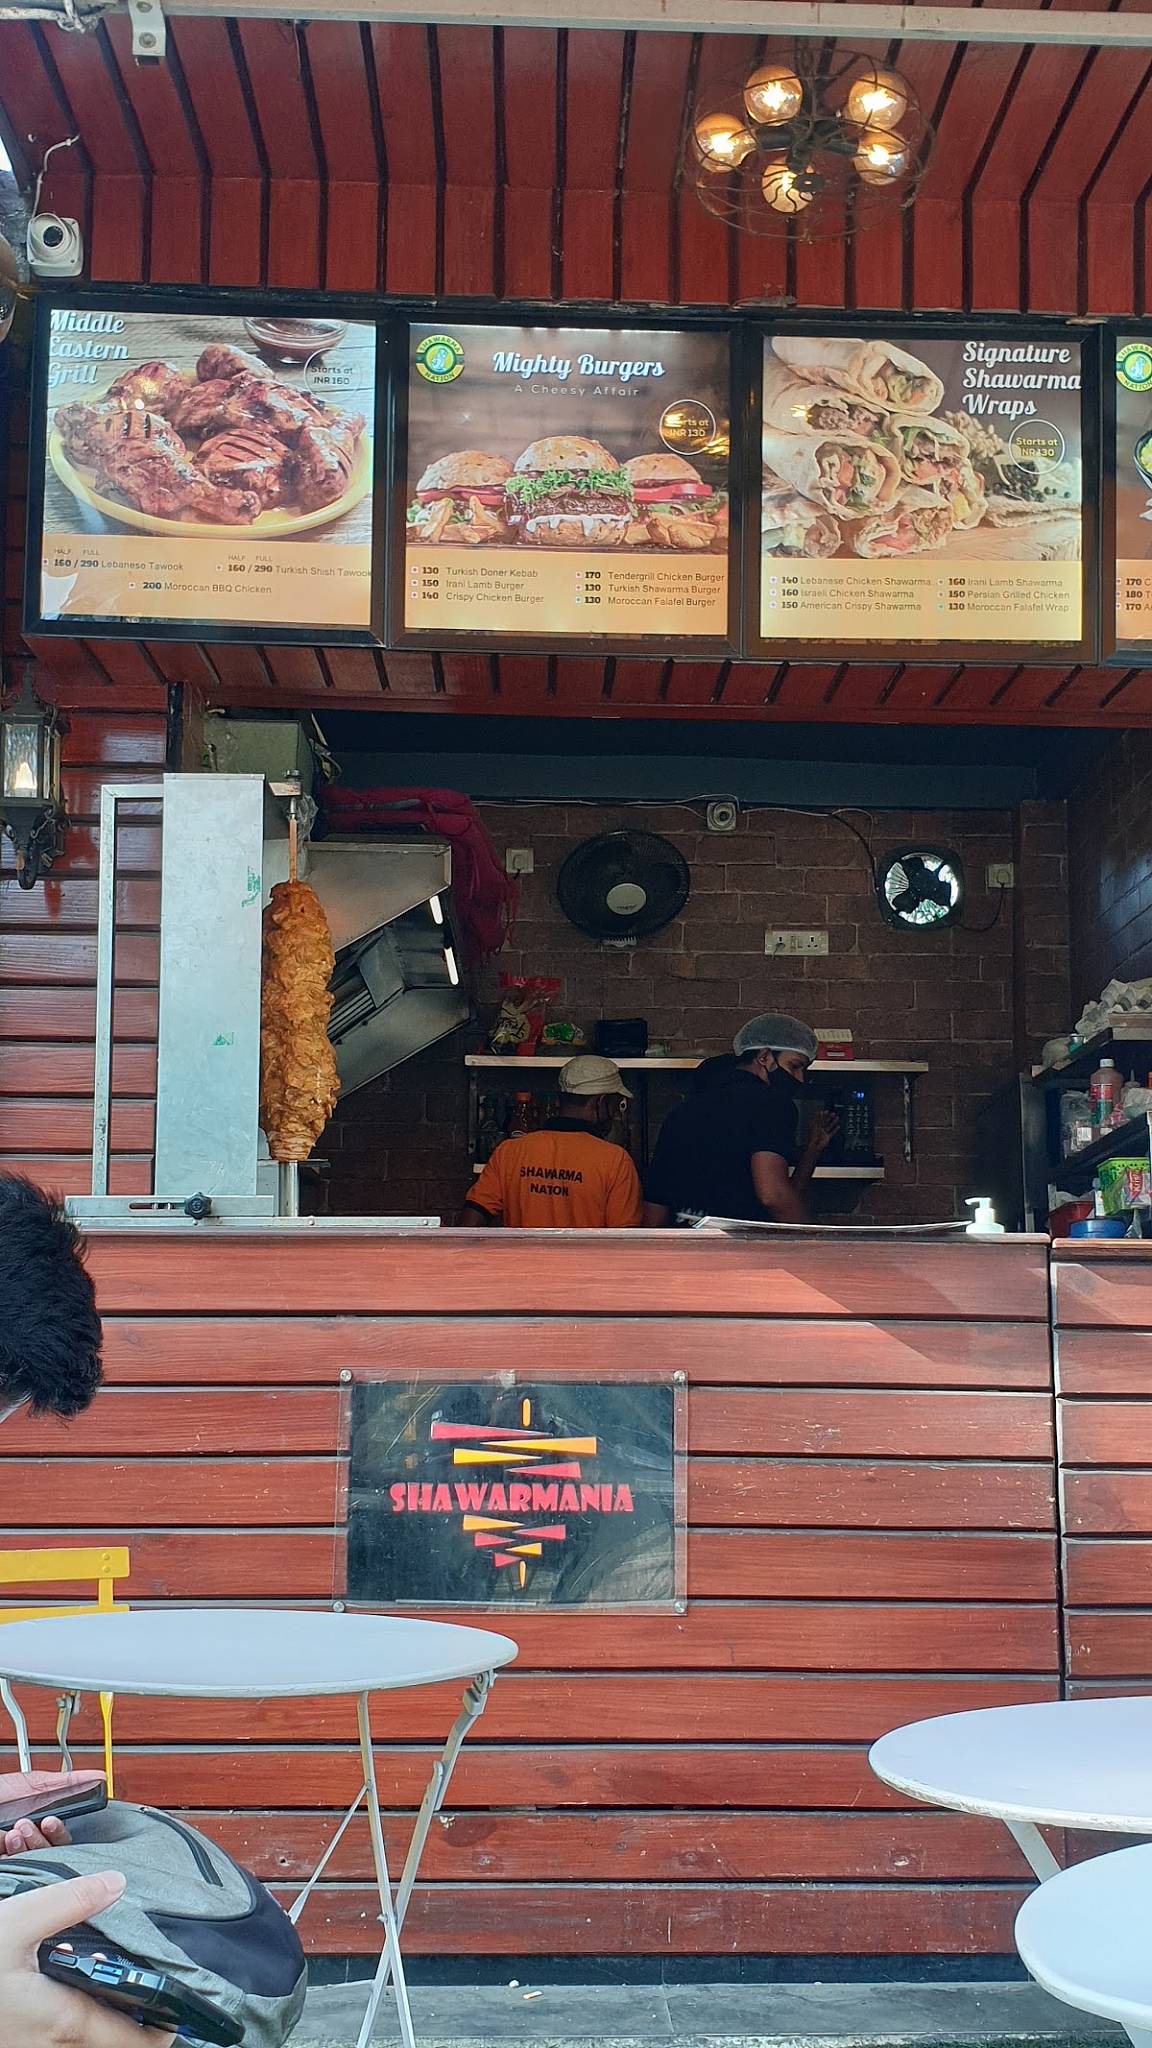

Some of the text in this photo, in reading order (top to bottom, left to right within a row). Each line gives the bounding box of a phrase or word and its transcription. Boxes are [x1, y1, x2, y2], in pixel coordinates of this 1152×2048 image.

[51, 311, 125, 334] Middle
[49, 336, 129, 360] Eastern
[962, 341, 1071, 368] Signature
[311, 366, 353, 375] Starts at
[493, 351, 666, 382] Mighty Burgers
[48, 362, 97, 388] Grill
[962, 367, 1082, 389] Shawarma
[514, 384, 640, 396] A Cheesy Affair
[962, 393, 1038, 421] Wraps
[688, 429, 706, 437] 130
[1016, 437, 1058, 446] Starts at
[54, 558, 72, 567] 160
[80, 559, 99, 568] 290
[101, 561, 146, 570] Lebanese
[149, 561, 184, 571] Tawook
[228, 564, 246, 573] 160
[254, 565, 273, 573] 290
[276, 565, 308, 575] Turkish
[310, 566, 335, 576] Shish
[422, 566, 538, 578] 130 Turkish Doner Kebab
[585, 571, 725, 583] 170 Tendergrill Chicken Burger
[422, 579, 524, 591] 150 Irani Lamb Burger
[781, 576, 931, 586] 140 Lebanese Chicken Shawarma
[948, 577, 1063, 587] 160 Irani Lamb Shawarma
[1126, 578, 1141, 586] 170
[143, 581, 272, 594] 200 Moroccan BBQ Chicken
[585, 584, 721, 596] 130 Turkish Shawarma Burger
[781, 588, 914, 598] 160 Israeli Chicken Shawarma
[422, 592, 544, 604] 140 Crispy Chicken Burger
[948, 590, 1070, 600] 150 Persian Grilled Chicken
[585, 596, 716, 608] 130 Moroccan Falafel Burger
[781, 601, 921, 612] 150 American Crispy Shawarma
[948, 602, 1069, 613] 130 Moroccan Falafel Wrap
[1126, 603, 1141, 611] 170
[530, 1182, 569, 1197] NATON
[389, 1483, 634, 1512] SHAWARMANIA
